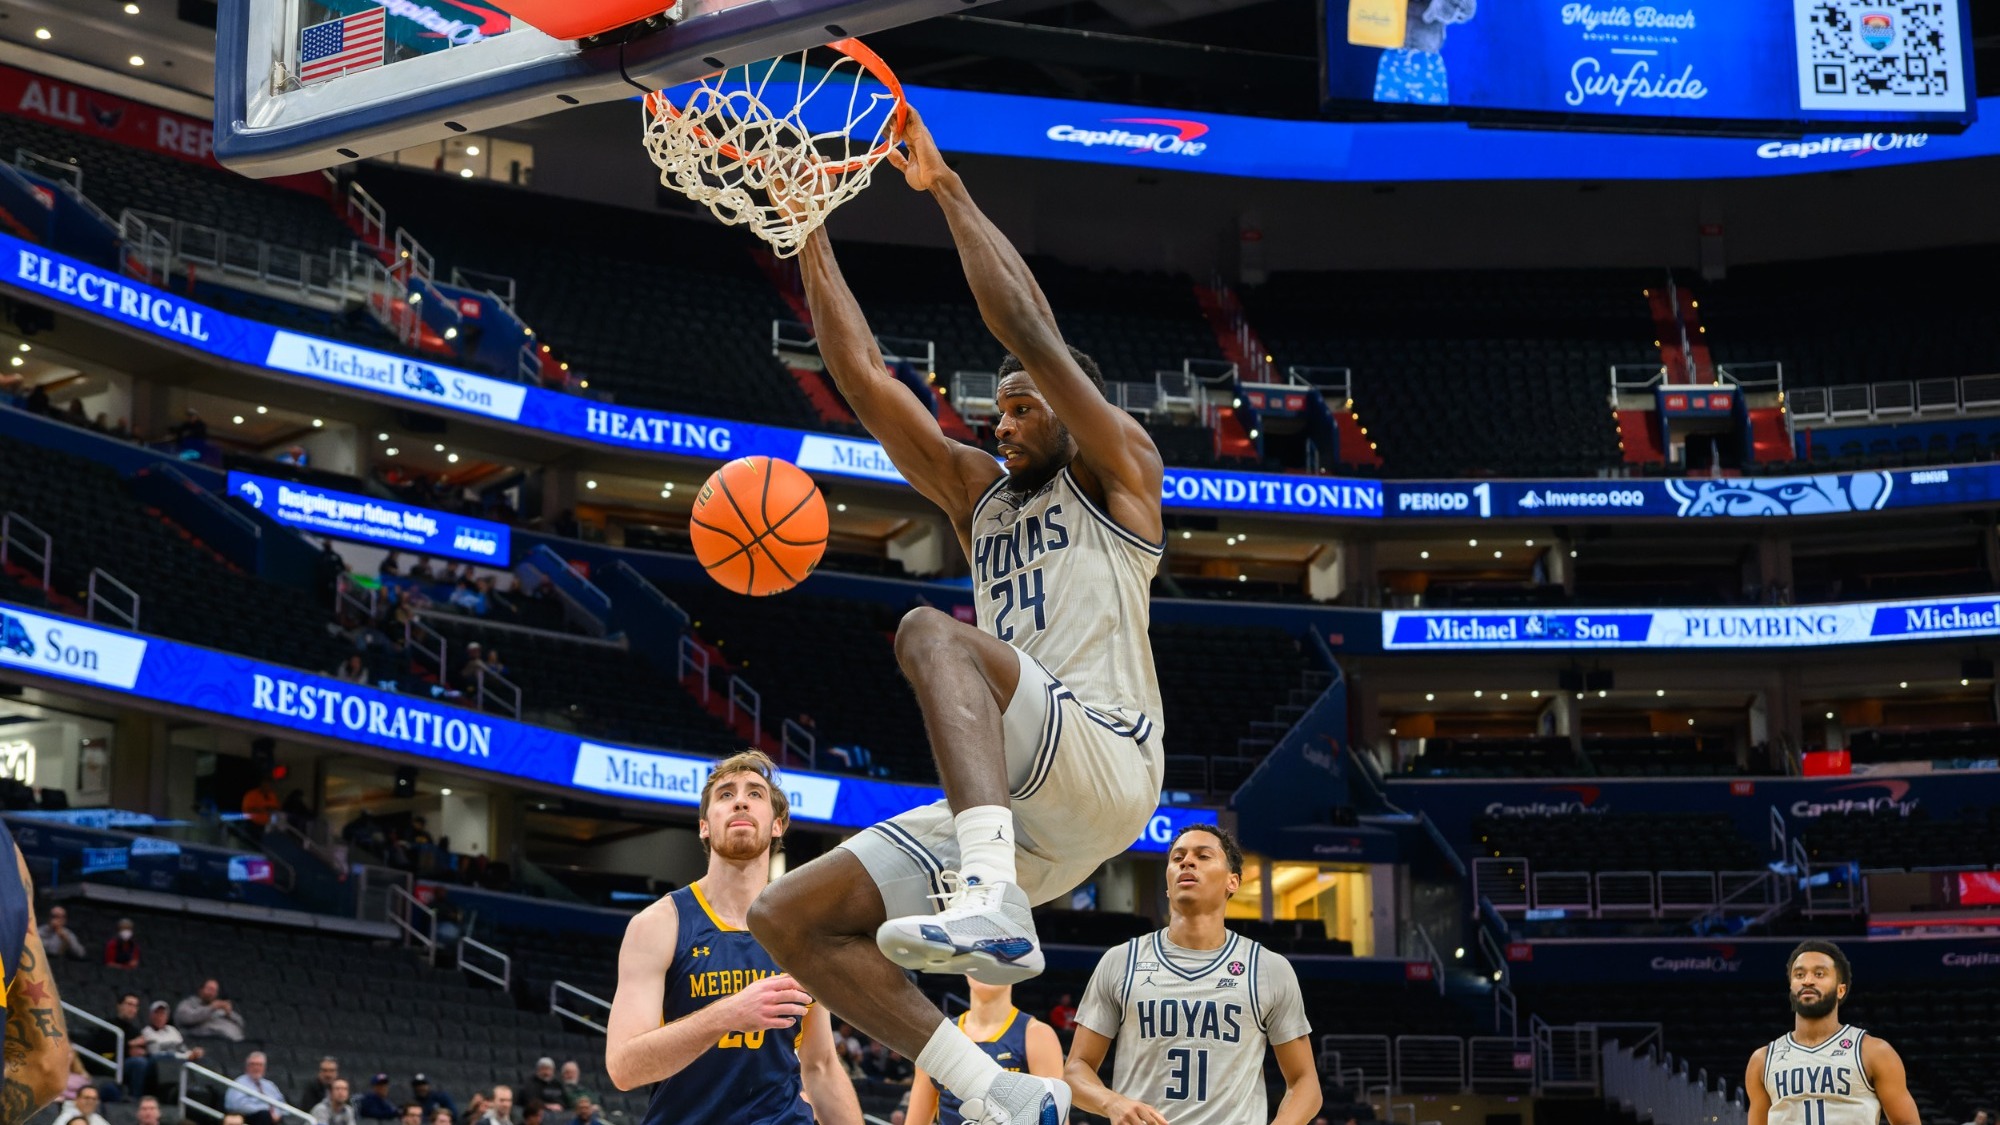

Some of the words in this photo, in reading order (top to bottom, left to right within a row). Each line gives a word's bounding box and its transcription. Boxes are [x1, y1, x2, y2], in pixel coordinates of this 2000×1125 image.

[1561, 3, 1632, 31] Myrtle
[1634, 6, 1696, 29] Beach
[1565, 57, 1708, 107] Surfside
[19, 80, 85, 125] ALL
[17, 249, 210, 342] ELECTRICAL
[306, 343, 396, 386] Michael
[451, 377, 493, 407] Son
[586, 407, 732, 453] HEATING
[832, 445, 897, 473] Mich
[278, 485, 338, 519] Designing
[337, 500, 364, 520] your
[1399, 492, 1469, 511] PERIOD
[1472, 482, 1492, 518] 1
[1545, 489, 1608, 507] Invesco
[1608, 490, 1645, 507] QQQ
[453, 534, 497, 556] KPMG
[990, 567, 1046, 643] 24
[1906, 601, 2000, 631] Michael
[1426, 617, 1517, 641] Michael
[1575, 616, 1620, 640] Son
[1685, 613, 1838, 638] PLUMBING
[44, 627, 99, 671] Son
[252, 673, 492, 759] RESTORATION
[605, 755, 699, 794] Michael
[1137, 999, 1243, 1044] HOYAS
[1165, 1048, 1209, 1102] 31
[1774, 1066, 1851, 1099] HOYAS
[1803, 1098, 1826, 1125] 11
